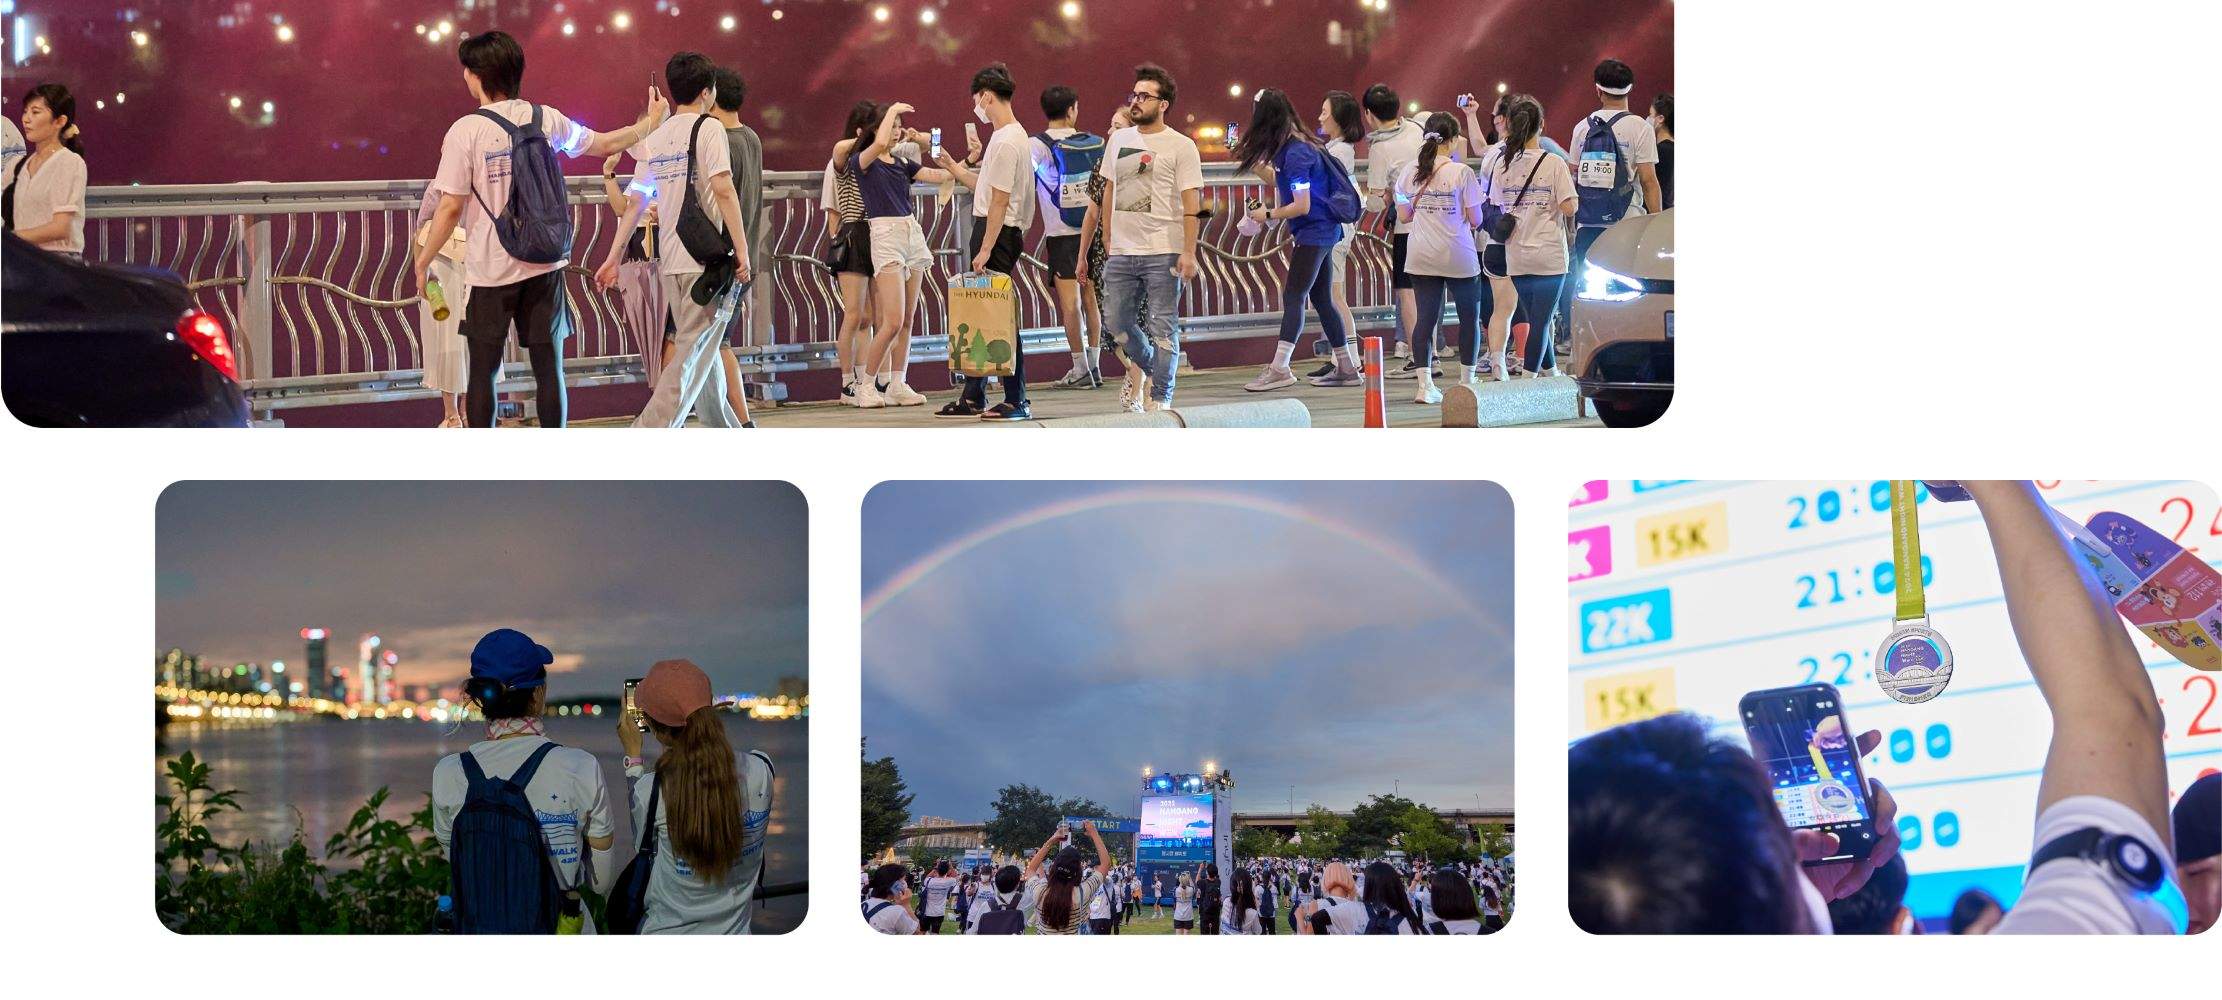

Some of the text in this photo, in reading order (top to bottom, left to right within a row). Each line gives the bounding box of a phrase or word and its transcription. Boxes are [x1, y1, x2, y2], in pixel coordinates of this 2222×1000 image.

[965, 291, 1009, 301] HYUNDAI
[1648, 518, 1708, 560] 15K
[1587, 601, 1656, 650] 22K
[1598, 683, 1656, 721] 15K
